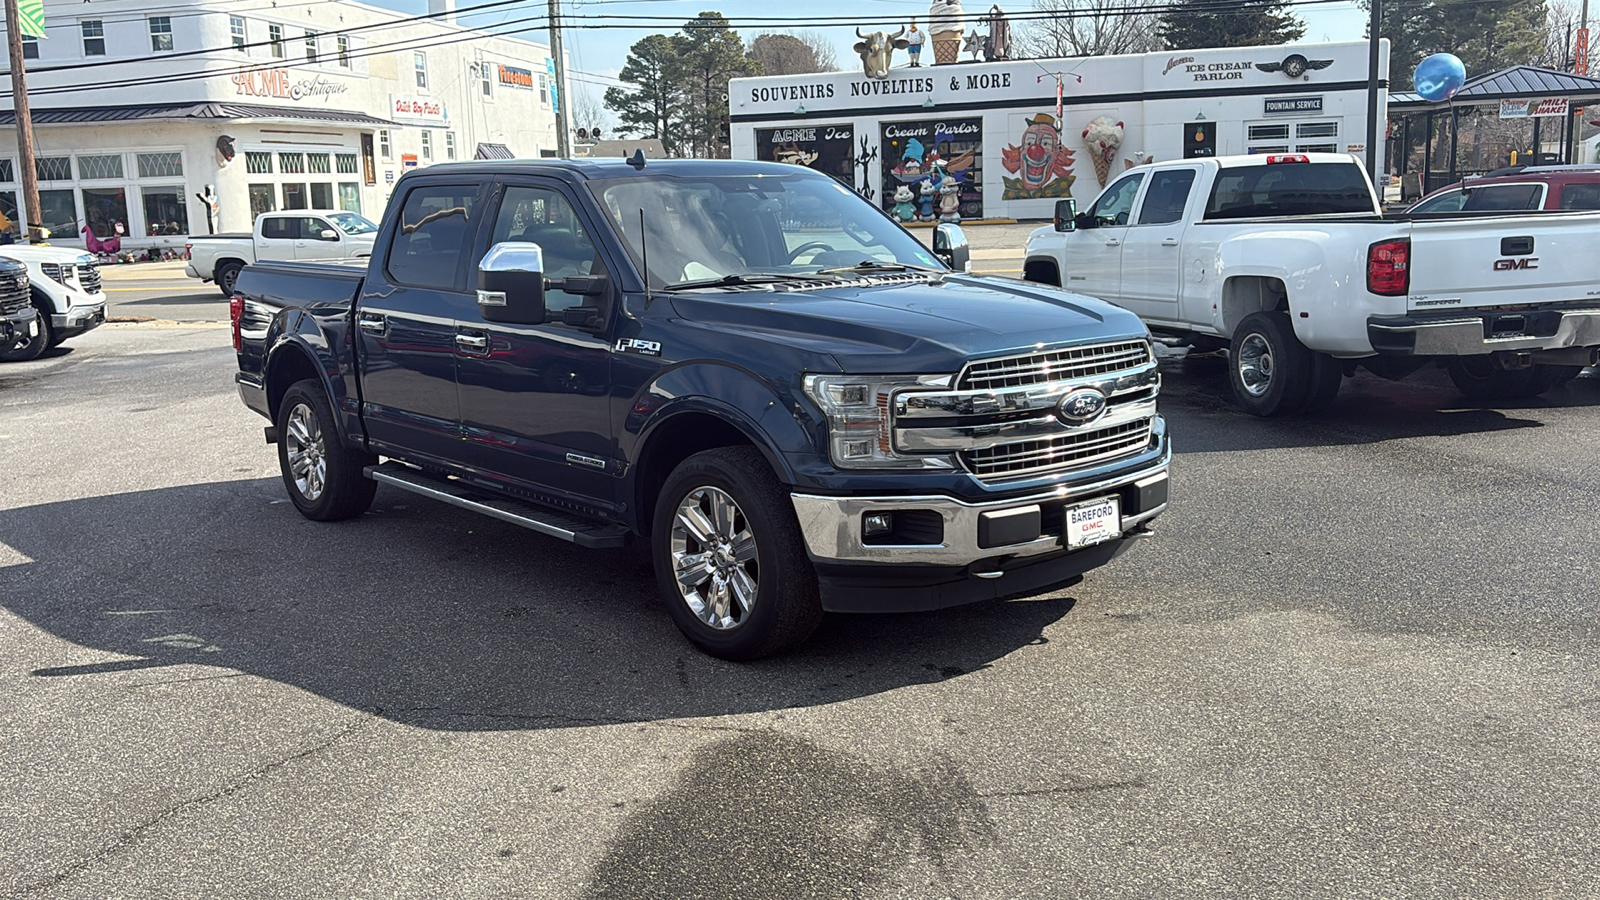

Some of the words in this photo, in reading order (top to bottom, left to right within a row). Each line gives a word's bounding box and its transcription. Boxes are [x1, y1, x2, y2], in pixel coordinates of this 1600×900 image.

[1185, 64, 1205, 73] ICE
[1207, 62, 1252, 71] CREAM
[231, 64, 291, 99] ACME
[498, 65, 532, 87] Firestone
[1193, 72, 1243, 82] PARLOR
[751, 84, 834, 103] SOUVENIRS
[850, 78, 933, 97] NOVELTIES
[949, 76, 960, 91] &
[966, 73, 1011, 90] MORE
[413, 101, 423, 117] Boy
[1266, 101, 1296, 111] FOUNTAIN
[1296, 99, 1321, 109] SERVICE
[1534, 106, 1567, 115] SHAKES
[1541, 98, 1568, 107] MILK
[772, 128, 816, 143] ACME
[825, 127, 851, 140] Ice
[885, 124, 928, 138] Cream
[935, 122, 980, 136] Parlor
[1494, 258, 1539, 271] GMC
[1072, 397, 1098, 415] Ford
[1071, 505, 1113, 524] BAREFORD
[1081, 520, 1103, 532] GMC
